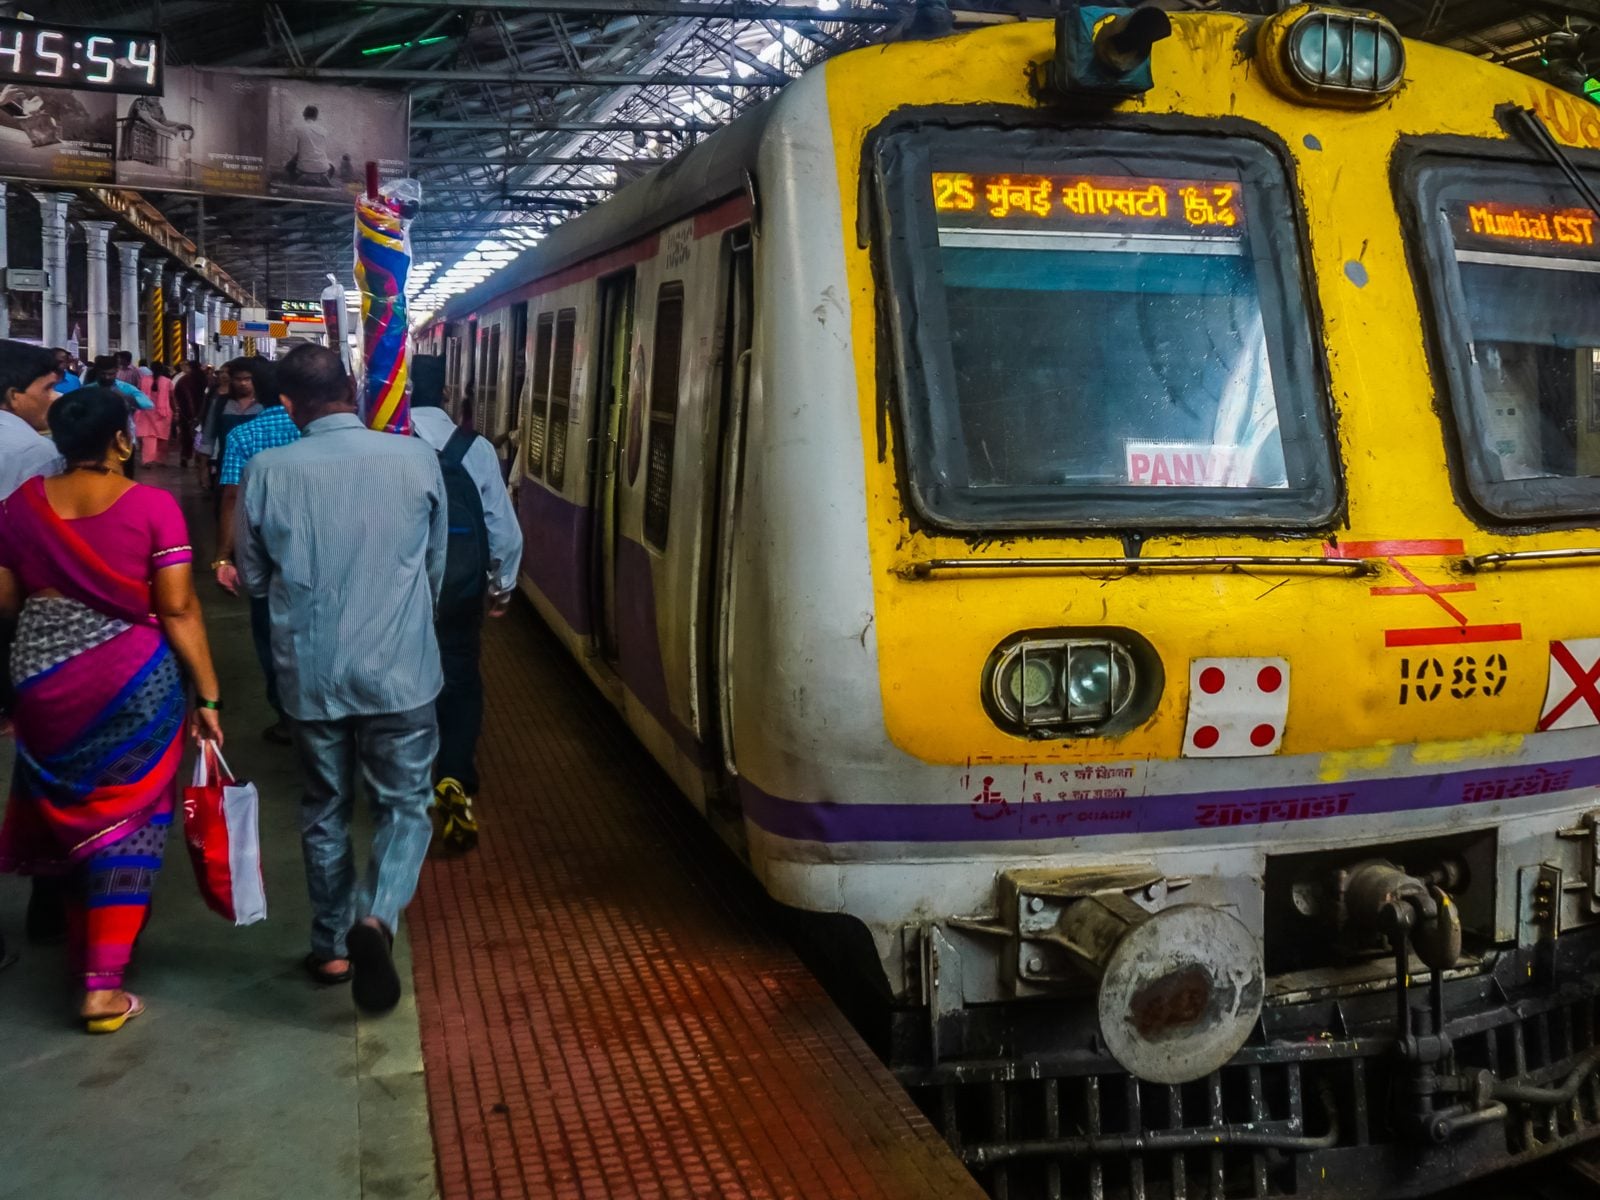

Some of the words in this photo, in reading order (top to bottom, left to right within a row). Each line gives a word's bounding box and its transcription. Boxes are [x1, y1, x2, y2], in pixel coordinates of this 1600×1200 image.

[986, 178, 1052, 218] मुंबई
[1062, 182, 1167, 218] सीएसटी
[1468, 205, 1553, 240] Mumbai
[1552, 215, 1594, 245] CST
[1398, 653, 1508, 705] 1089
